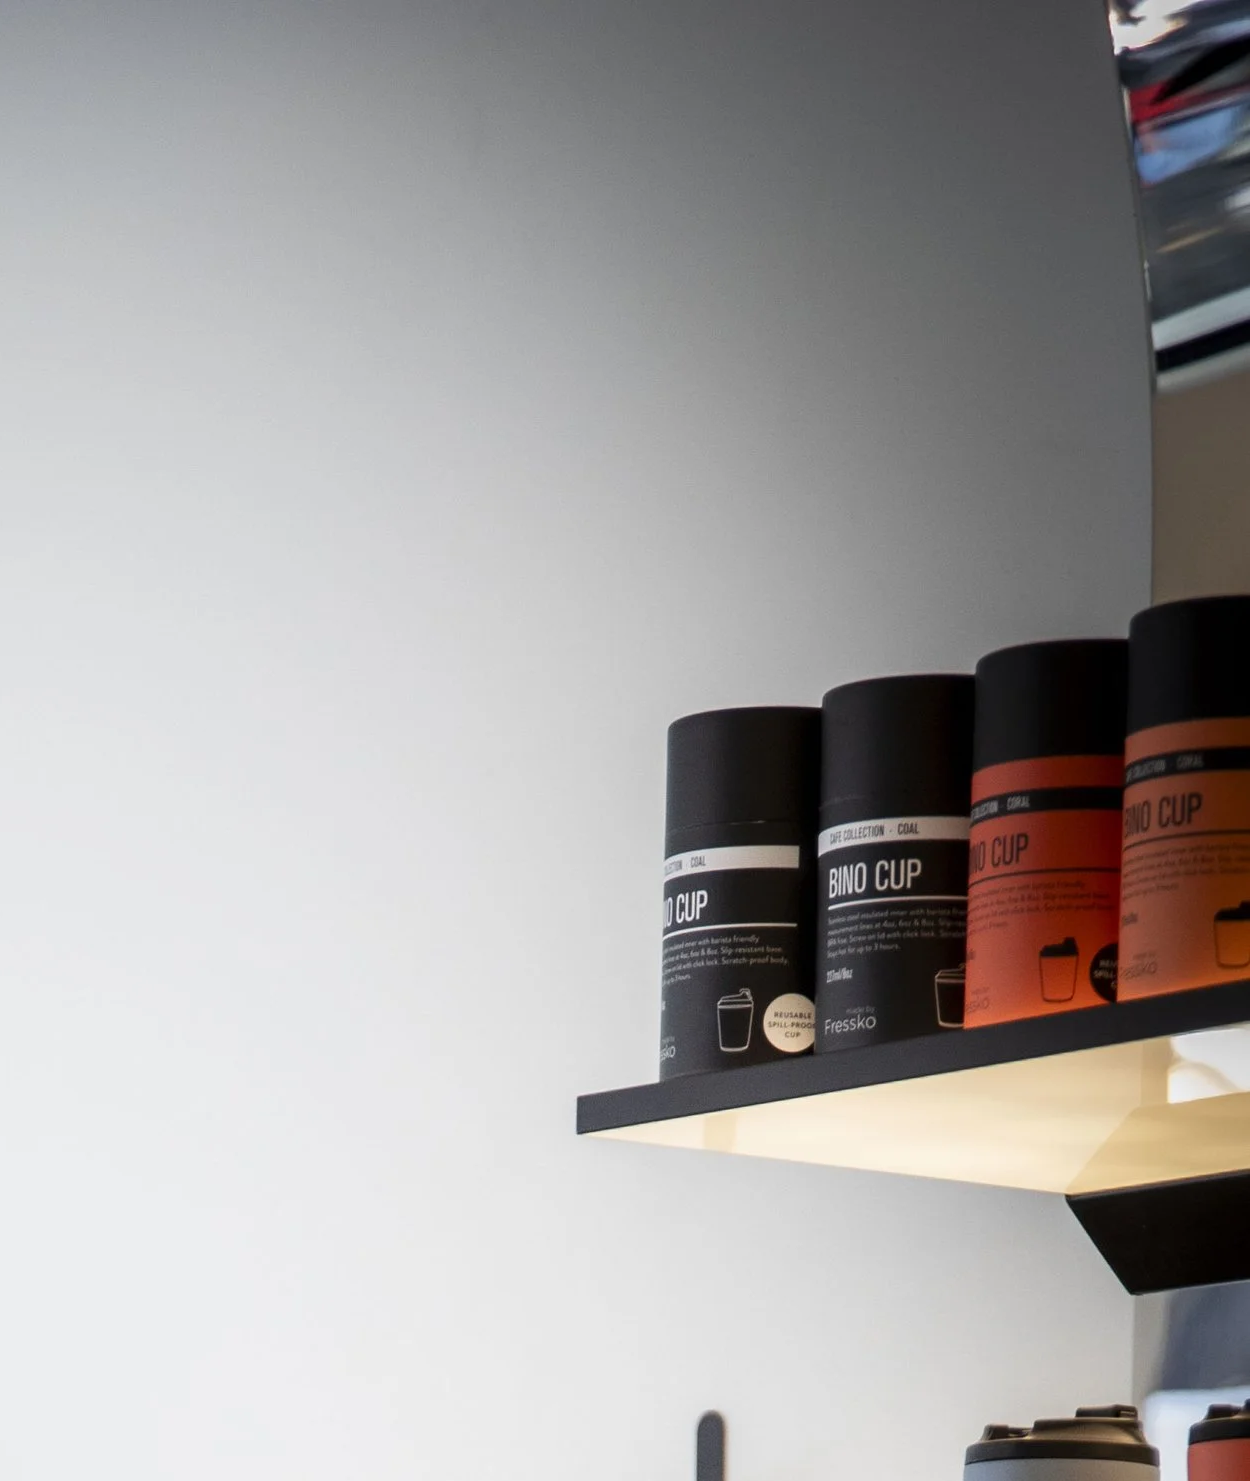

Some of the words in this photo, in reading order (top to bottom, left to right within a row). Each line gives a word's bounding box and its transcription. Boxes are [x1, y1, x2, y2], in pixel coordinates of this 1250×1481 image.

[1158, 792, 1202, 828] CUP
[844, 824, 884, 842] COLLECTION
[898, 822, 920, 835] COAL
[690, 856, 706, 868] COAL
[992, 833, 1029, 868] CUP
[829, 862, 867, 898] BINO
[875, 858, 922, 892] CUP
[676, 890, 708, 924] CUP
[824, 1014, 877, 1036] Fressko
